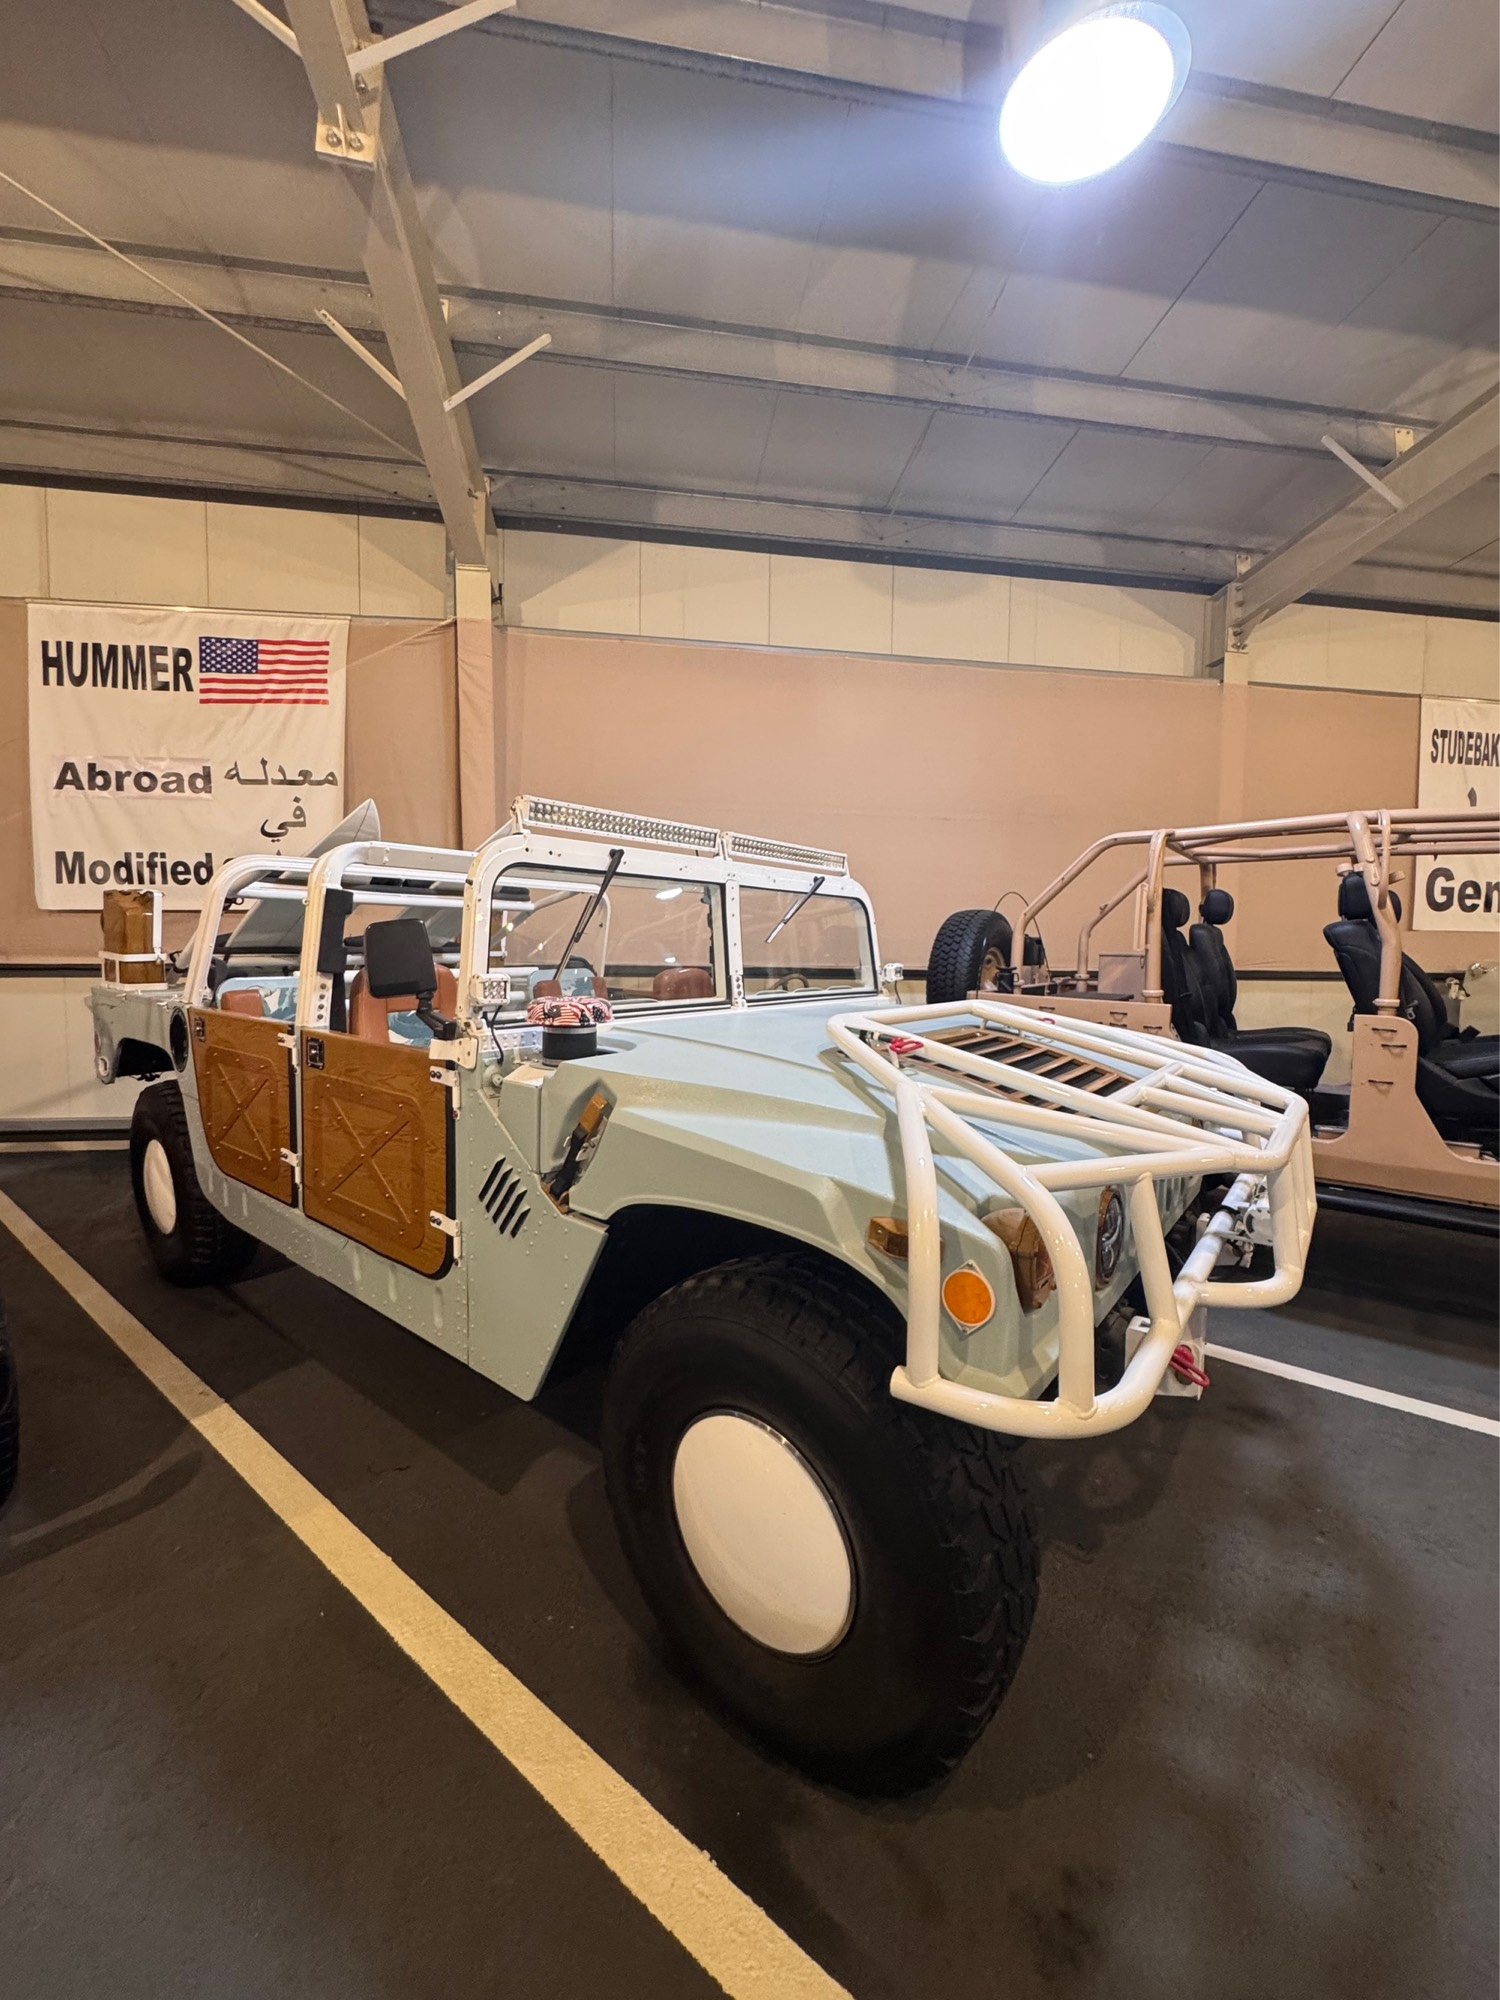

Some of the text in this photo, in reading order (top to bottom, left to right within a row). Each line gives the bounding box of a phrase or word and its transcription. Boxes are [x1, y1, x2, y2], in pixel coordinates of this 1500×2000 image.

[41, 640, 194, 692] HUMMER
[53, 762, 213, 794] Abroad
[224, 757, 338, 786] معدله
[260, 796, 307, 843] في
[55, 851, 213, 885] Modified
